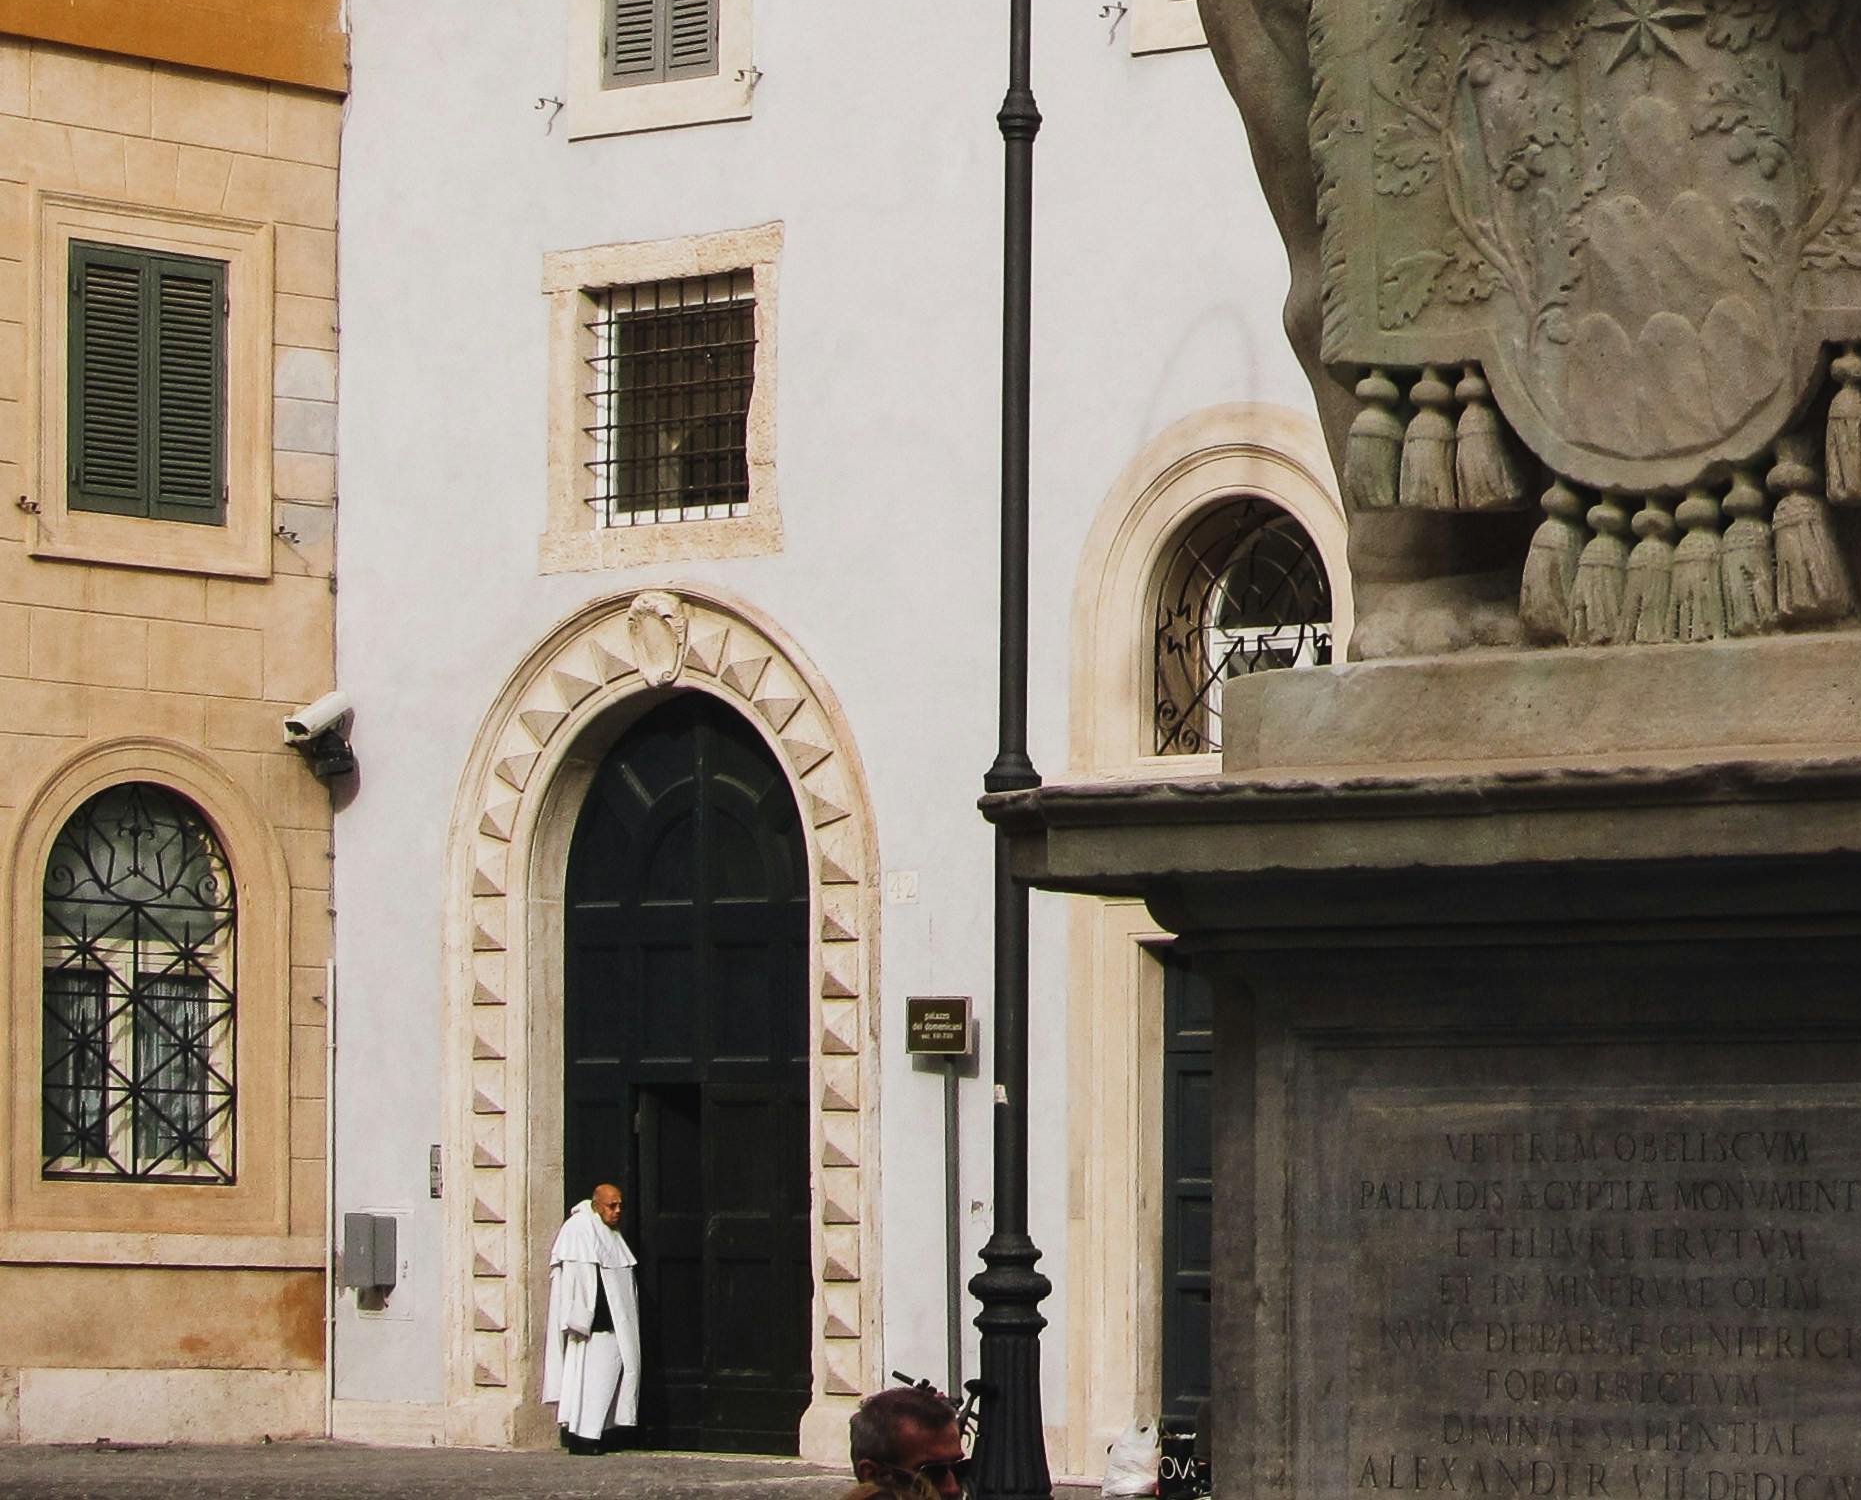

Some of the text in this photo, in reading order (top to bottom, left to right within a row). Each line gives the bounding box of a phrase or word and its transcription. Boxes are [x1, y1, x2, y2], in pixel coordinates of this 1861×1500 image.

[1445, 1132, 1808, 1164] VETEREM OBELISCVM
[1359, 1179, 1504, 1211] PALLADIS
[1486, 1227, 1635, 1259] TELLVRE
[1651, 1228, 1806, 1260] ERVTVM
[1439, 1273, 1821, 1310] ET IN MINERVAE OLIM
[1379, 1319, 1471, 1352] NVNC
[1485, 1321, 1649, 1356] DEIPARAE
[1485, 1369, 1760, 1407] FORO ERECTVM
[1442, 1413, 1806, 1456] DIVINAE SAPIENTIAE
[1357, 1455, 1611, 1497] ALEXANDER
[1631, 1463, 1688, 1500] VII
